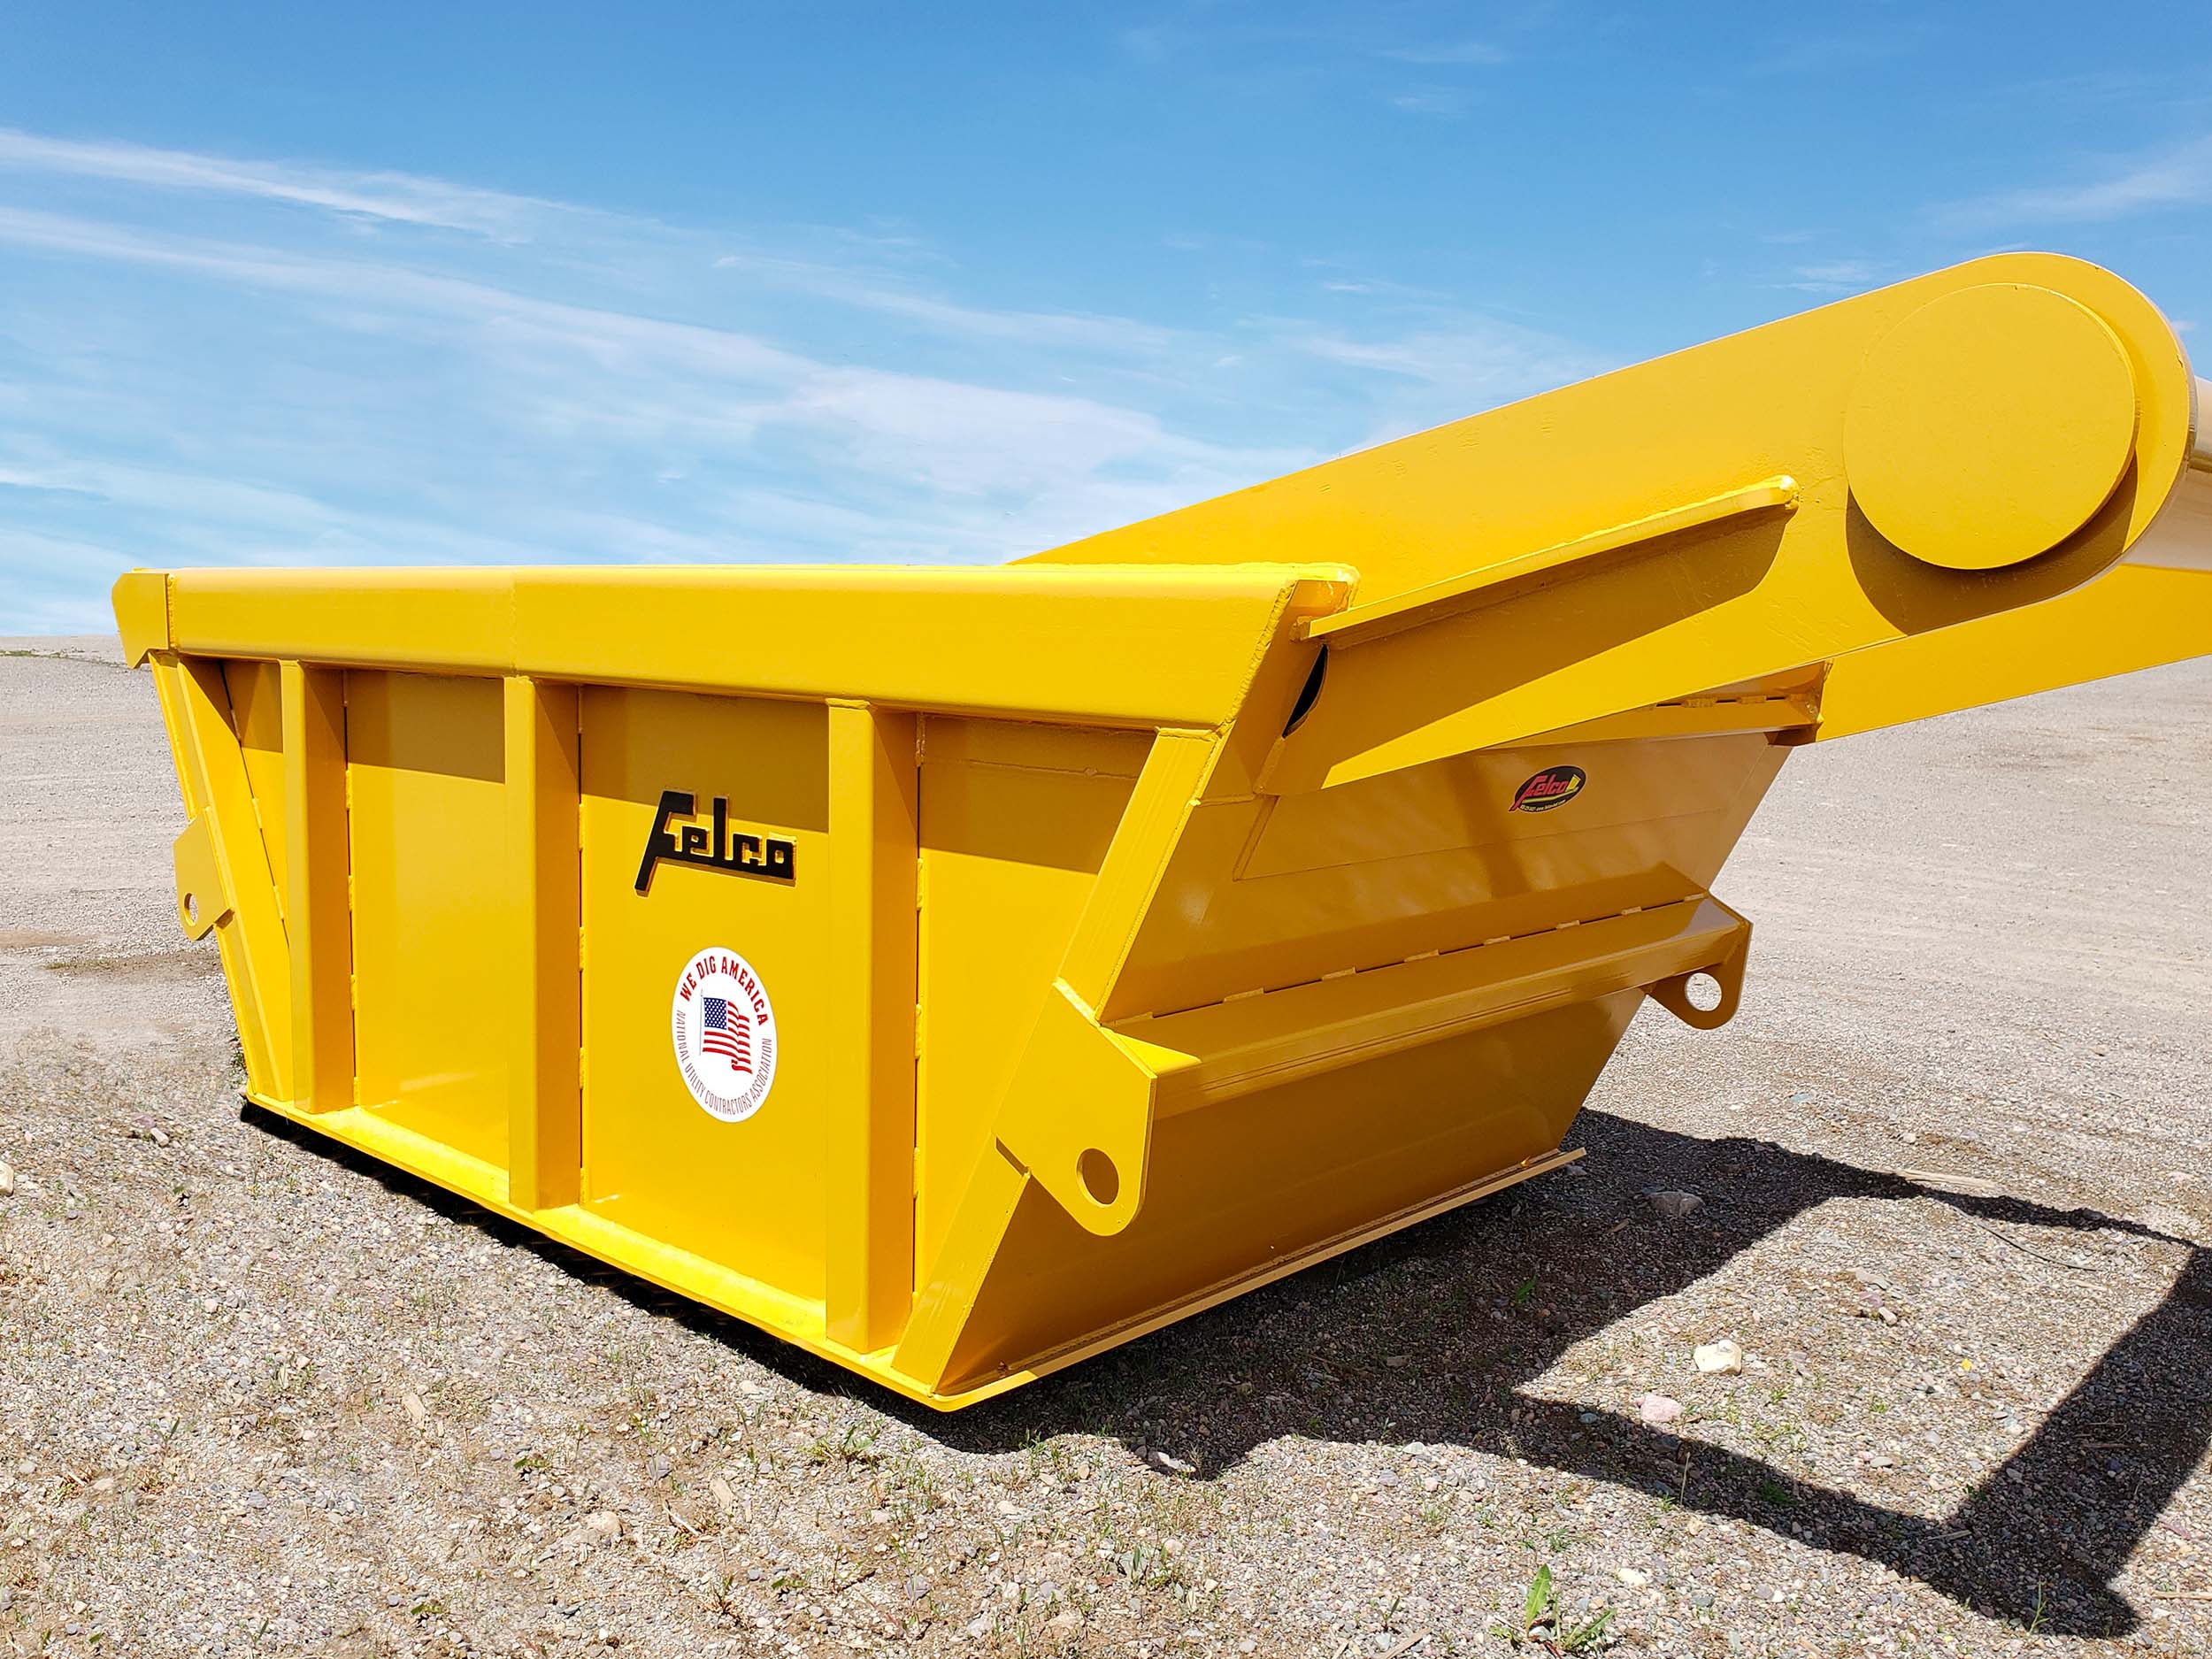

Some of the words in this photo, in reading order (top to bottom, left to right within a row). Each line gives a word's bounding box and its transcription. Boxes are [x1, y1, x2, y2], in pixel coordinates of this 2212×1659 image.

[1509, 774, 1569, 811] Felco
[635, 791, 794, 891] Felco
[680, 972, 697, 1002] WE
[695, 955, 717, 980] DIG
[721, 956, 769, 1026] AMERICA
[676, 1010, 687, 1064] NATIONAL
[685, 1063, 705, 1098] UTILITY
[704, 1089, 752, 1116] CONTRACTORS
[749, 1038, 772, 1102] ASSOCIATION
